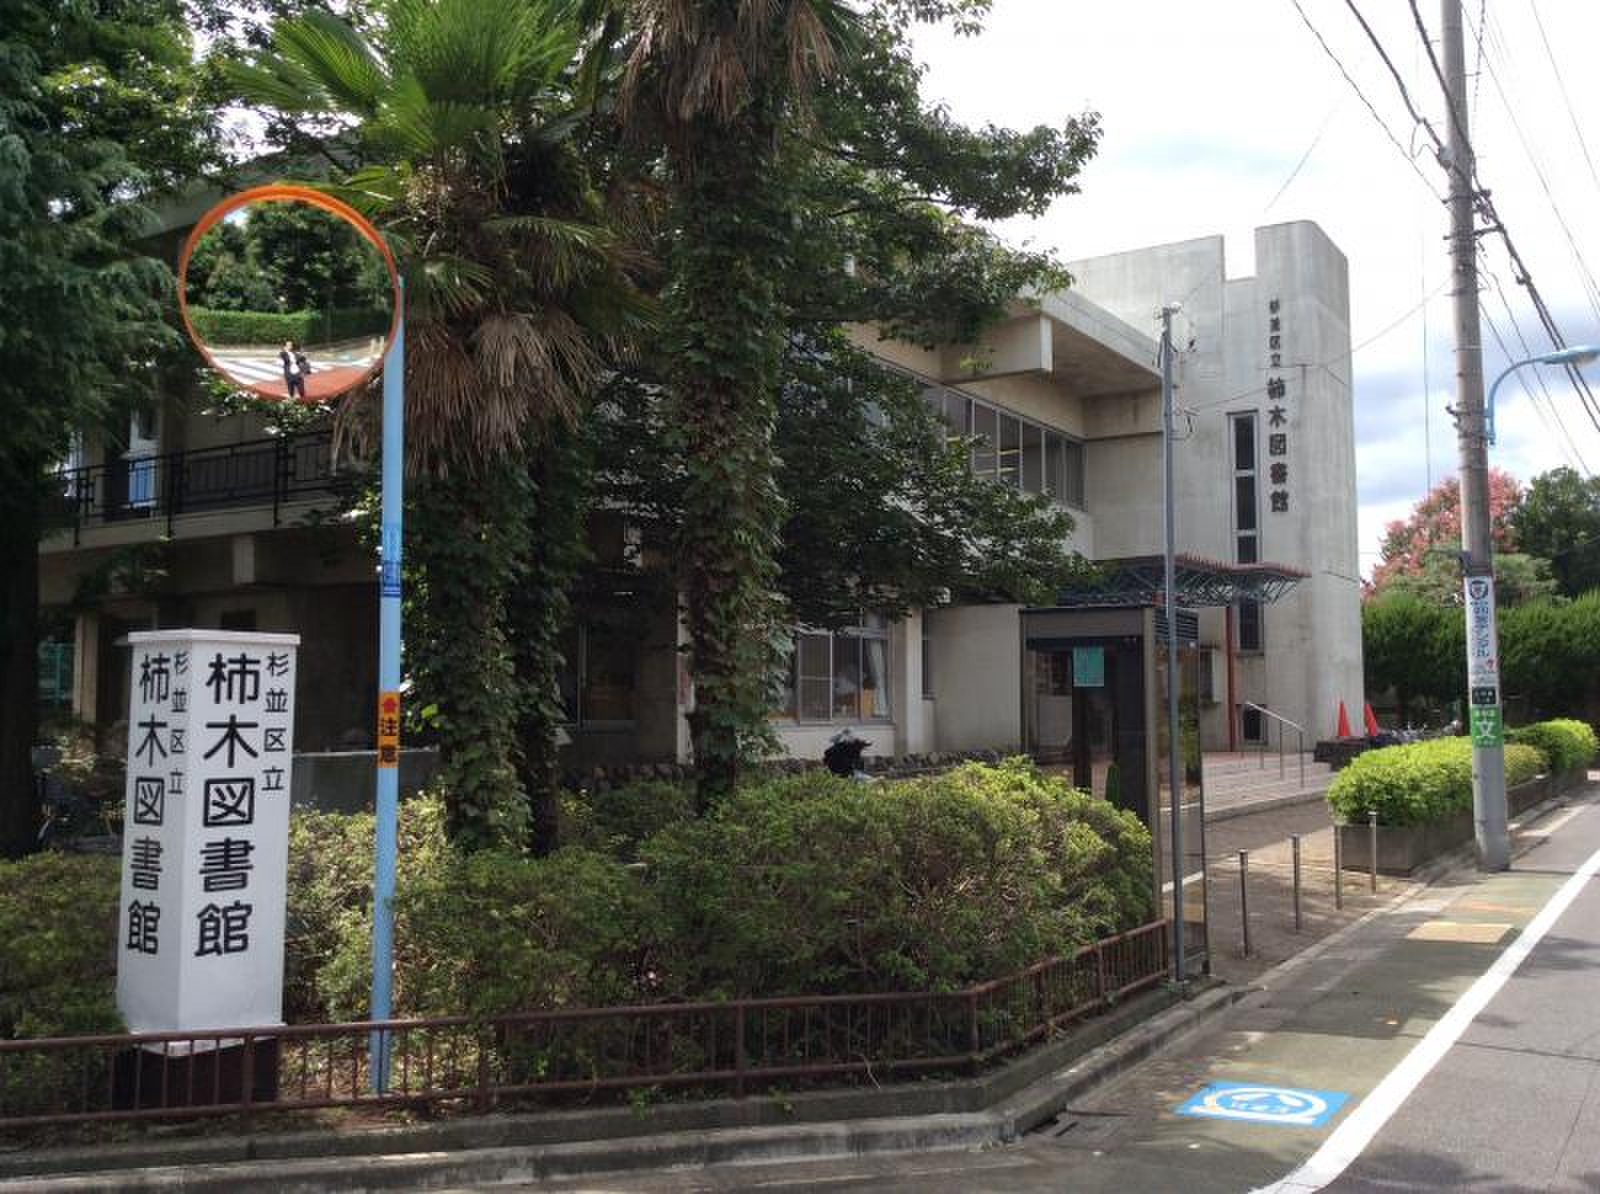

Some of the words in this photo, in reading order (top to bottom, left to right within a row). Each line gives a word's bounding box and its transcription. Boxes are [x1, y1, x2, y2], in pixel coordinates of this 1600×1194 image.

[127, 651, 171, 956] 柿木図書館
[167, 650, 190, 796] 杉並区立
[194, 652, 262, 958] 柿木図書館
[261, 650, 290, 792] 杉並区立
